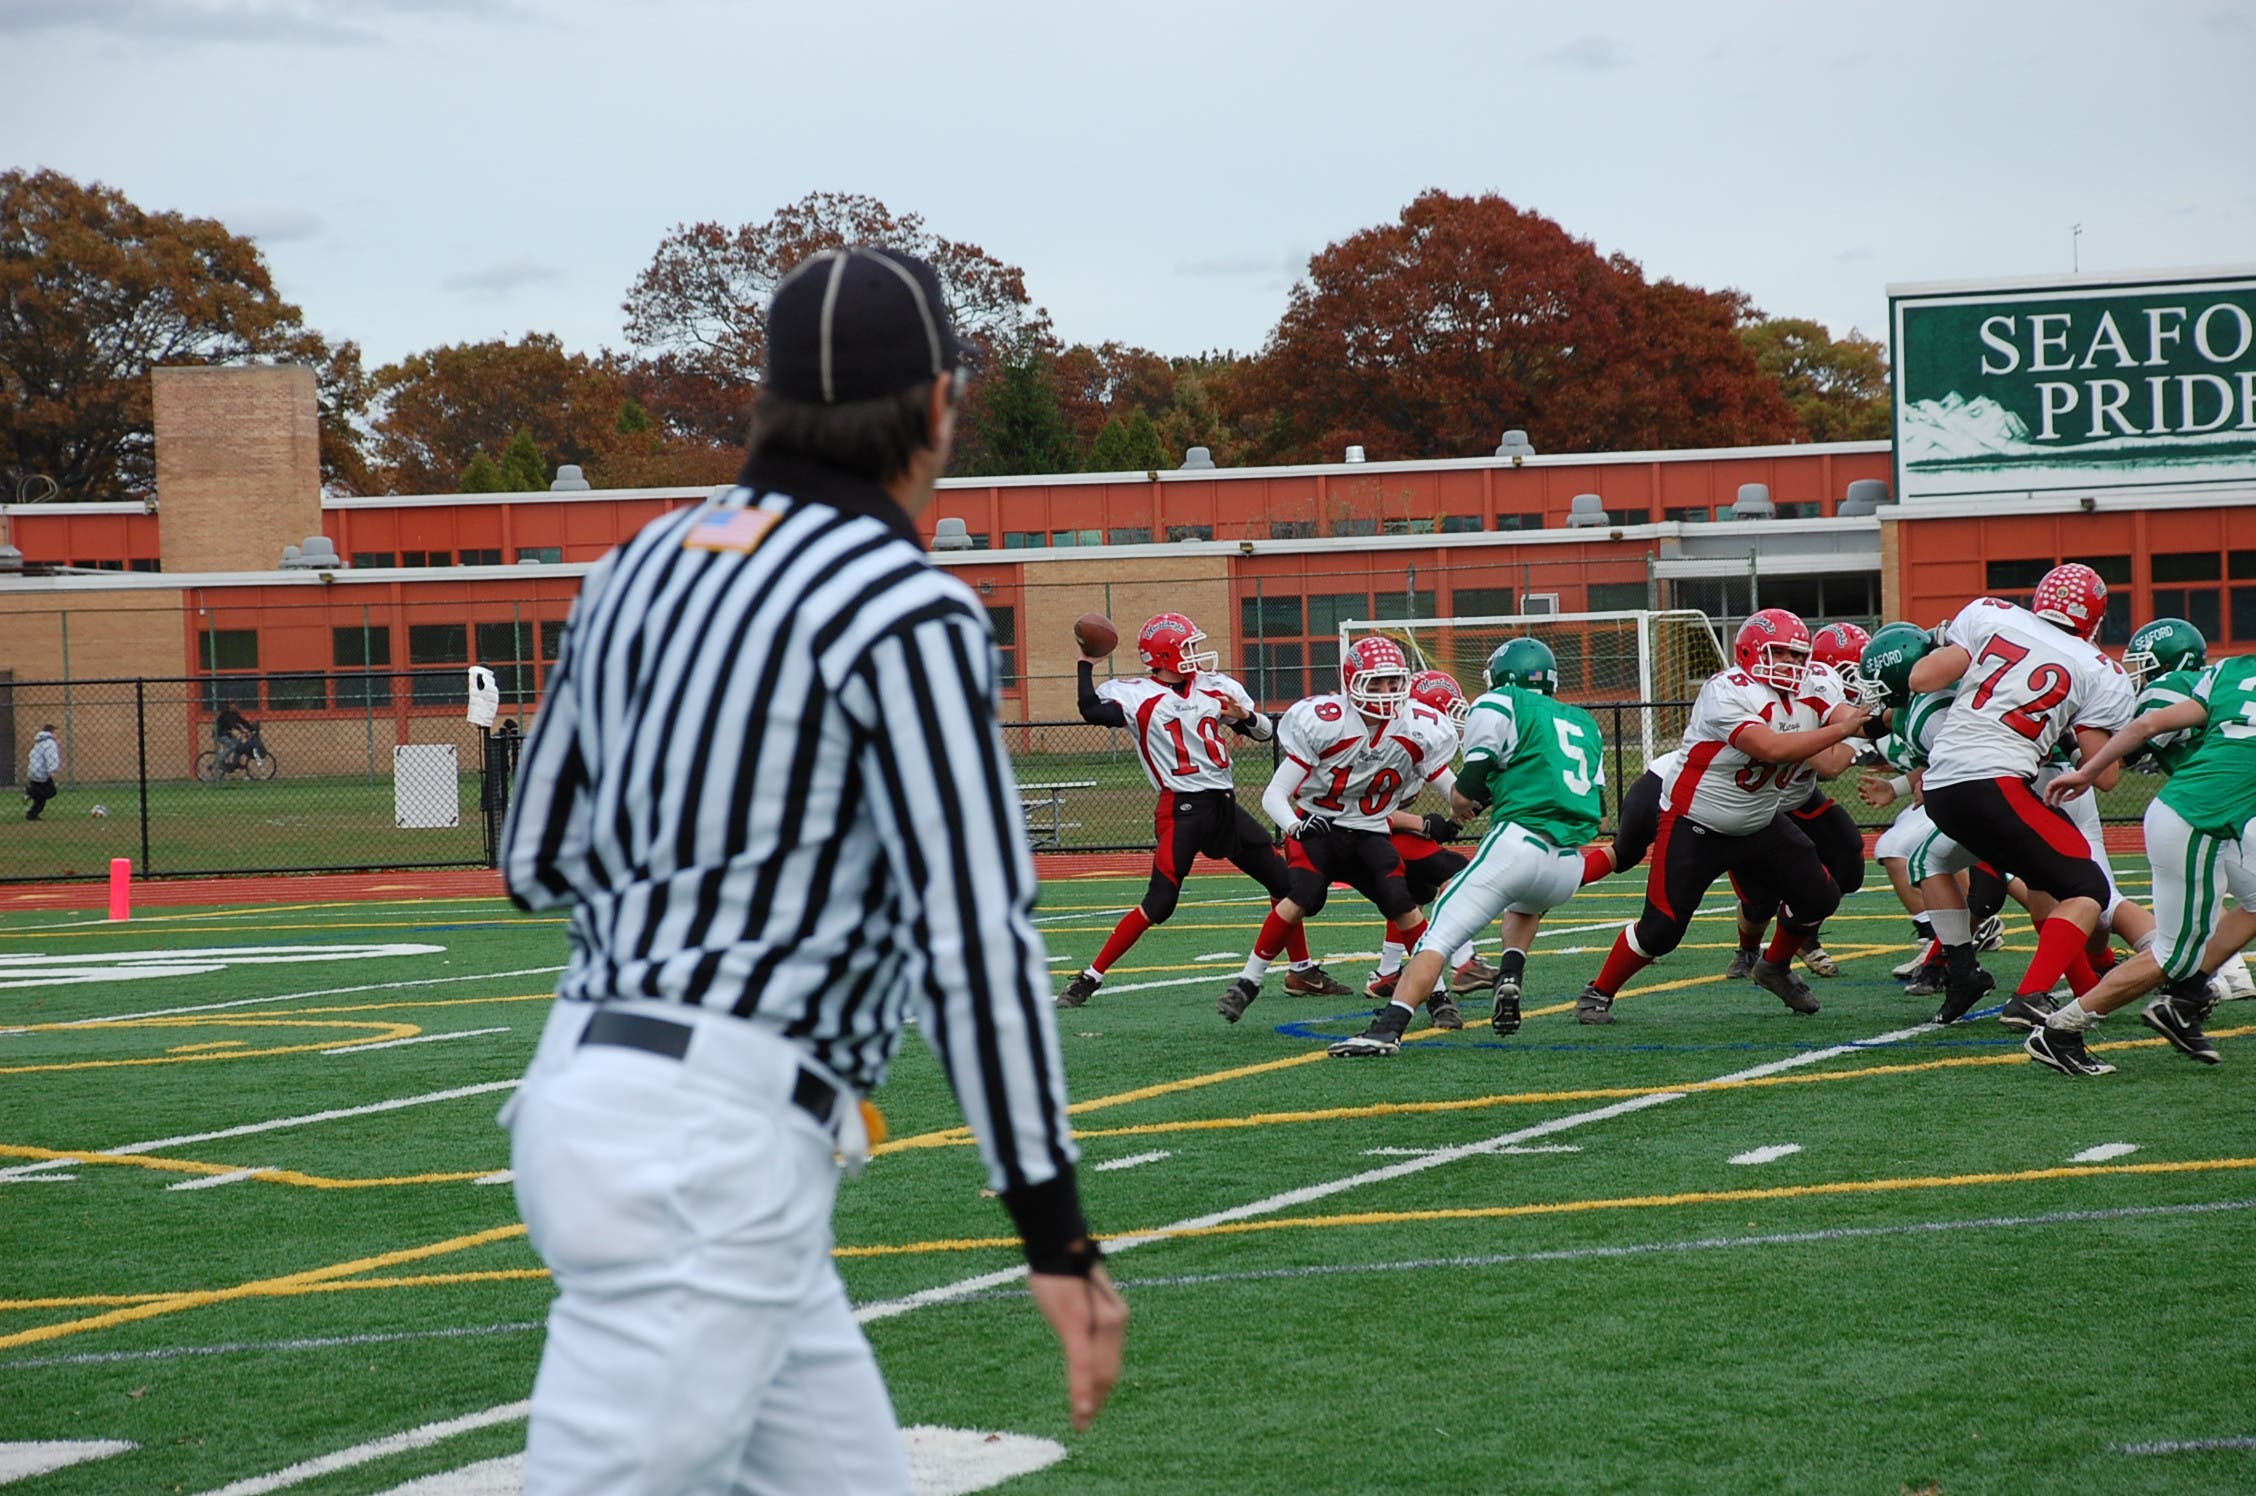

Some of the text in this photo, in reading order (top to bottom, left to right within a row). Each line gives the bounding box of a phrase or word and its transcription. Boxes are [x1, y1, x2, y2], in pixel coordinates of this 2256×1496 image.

[1865, 648, 1903, 674] SEAFORD
[2134, 624, 2174, 652] SEAFORD
[1970, 632, 2073, 742] 72
[1552, 716, 1593, 797] 5
